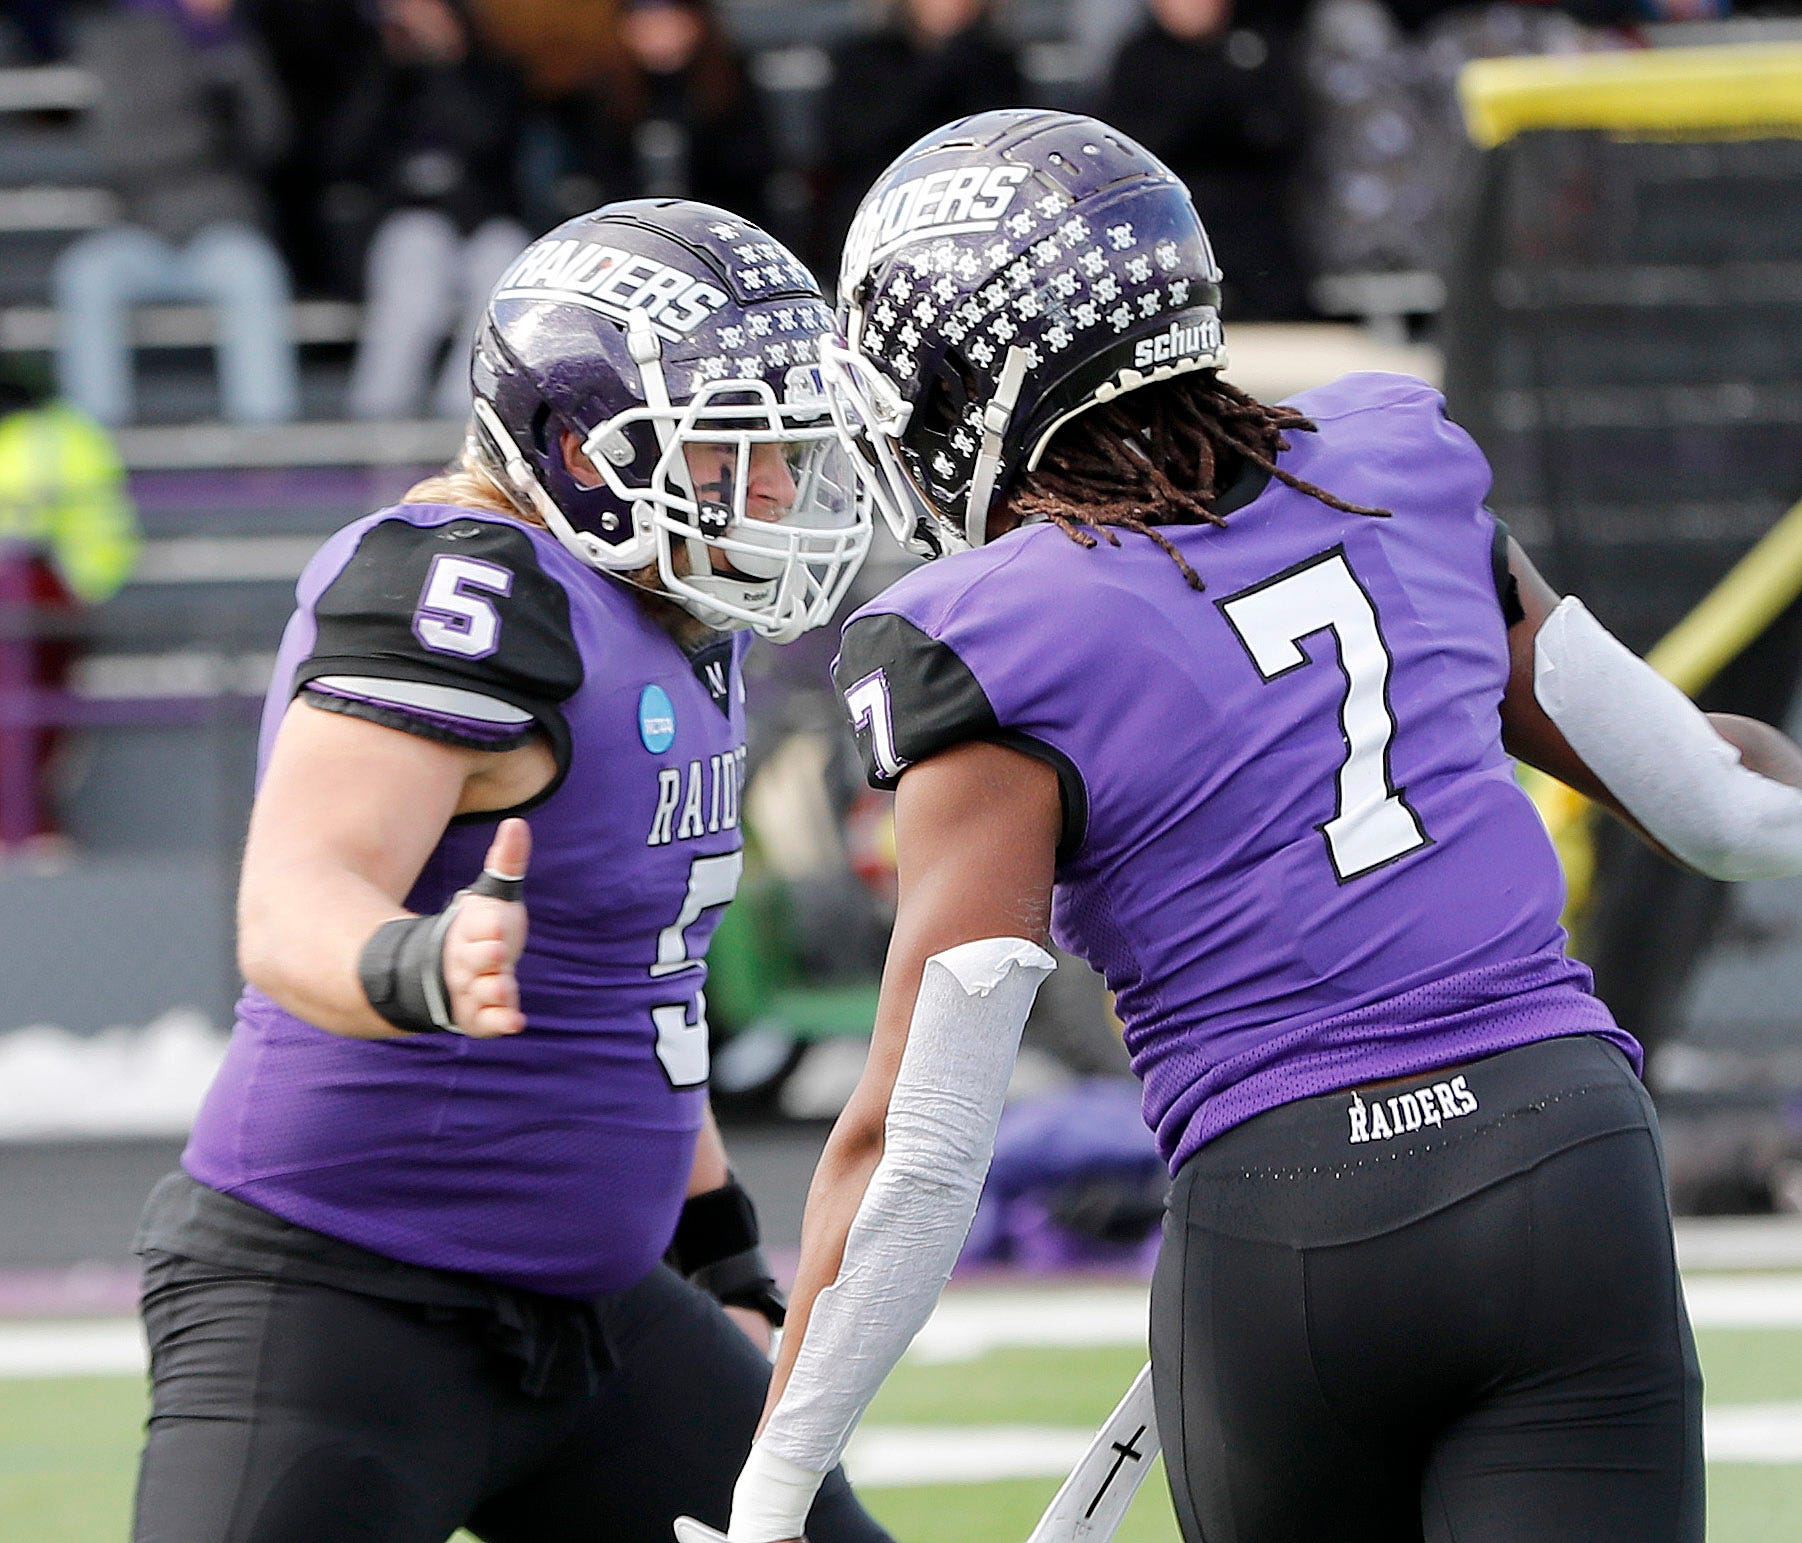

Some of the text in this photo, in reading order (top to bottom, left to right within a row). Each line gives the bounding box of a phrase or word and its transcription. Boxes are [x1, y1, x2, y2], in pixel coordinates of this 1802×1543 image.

[503, 239, 728, 332] RAIDERS
[411, 554, 515, 661] 5
[843, 667, 908, 779] 7
[1212, 542, 1437, 886] 7
[647, 743, 747, 846] RAID
[648, 850, 744, 1086] 5
[1348, 1075, 1478, 1143] RAIDERS
